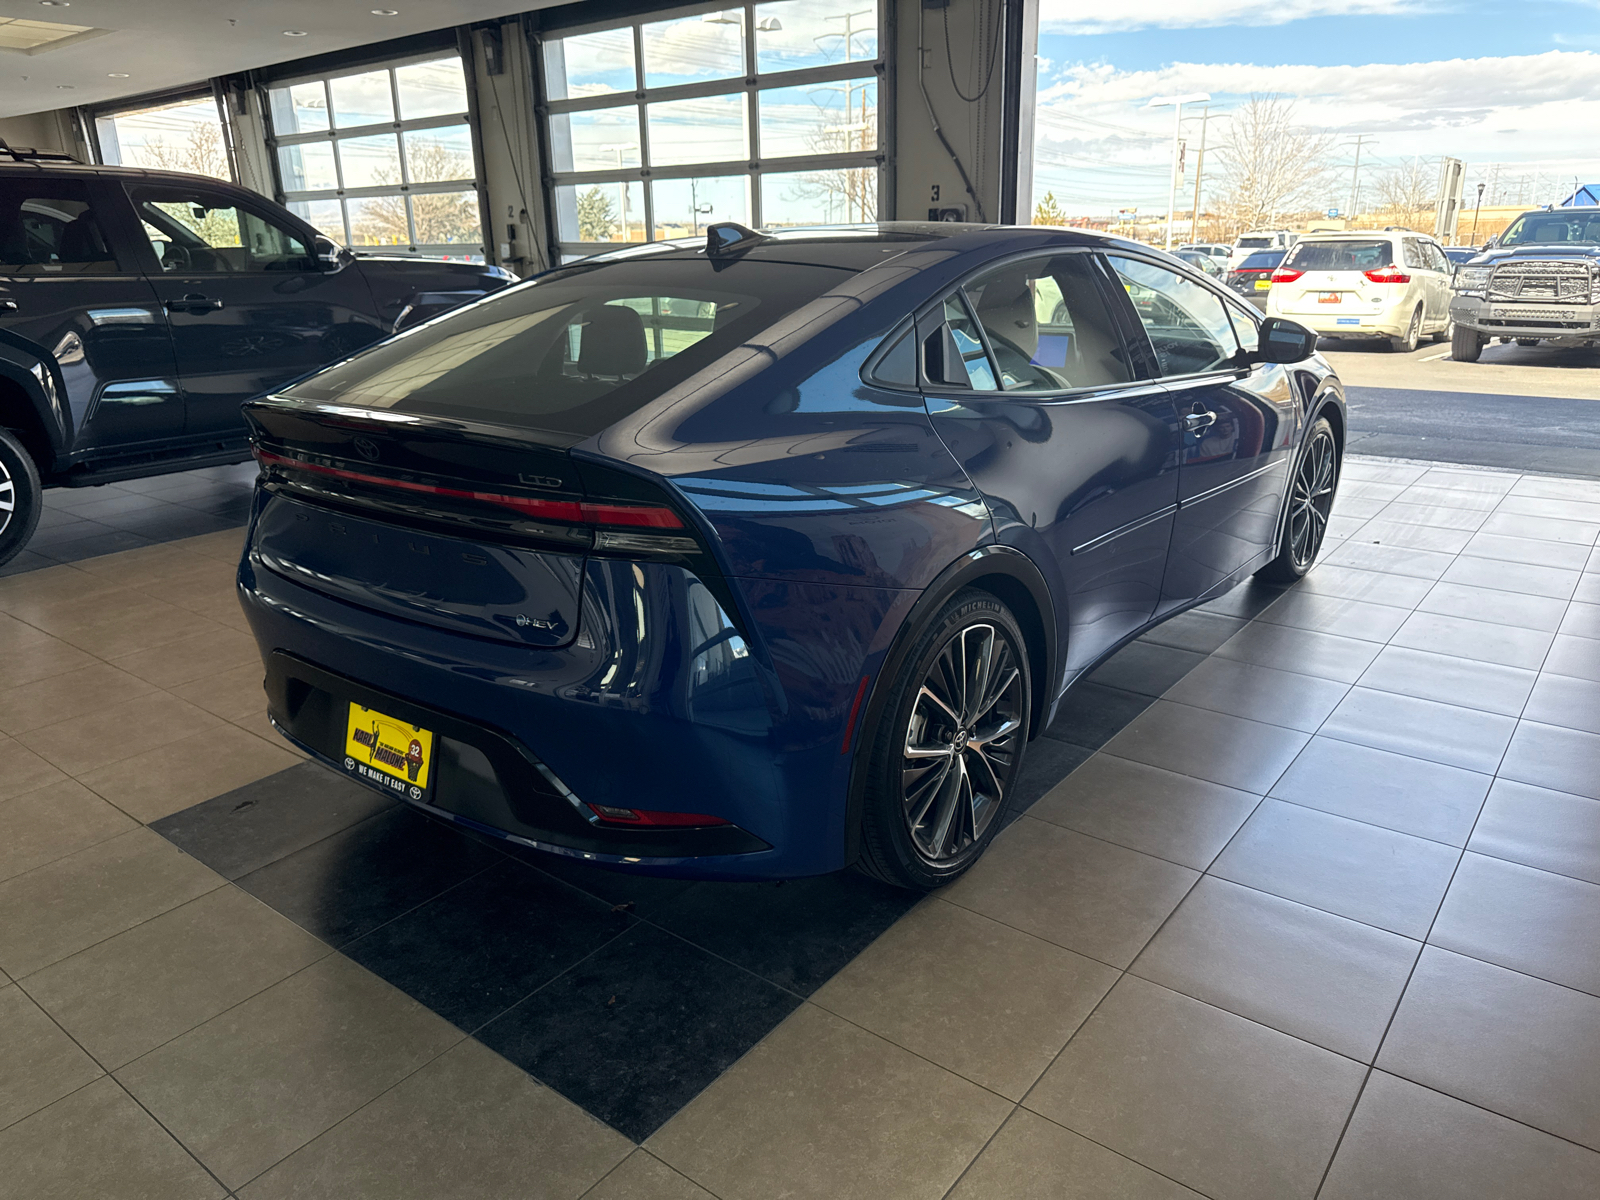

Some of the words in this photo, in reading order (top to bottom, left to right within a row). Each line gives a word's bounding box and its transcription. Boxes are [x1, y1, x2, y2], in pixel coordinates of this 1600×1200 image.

[931, 184, 940, 202] 3
[508, 205, 514, 218] 2
[518, 472, 563, 488] LTD
[295, 513, 489, 567] PRIUS
[960, 600, 1000, 616] MICHELIN
[352, 727, 374, 749] KARL
[374, 745, 406, 771] MALONE
[410, 744, 420, 757] 32
[358, 764, 367, 776] WE
[368, 769, 383, 782] MAKE
[384, 776, 390, 786] IT
[391, 779, 406, 793] EASY
